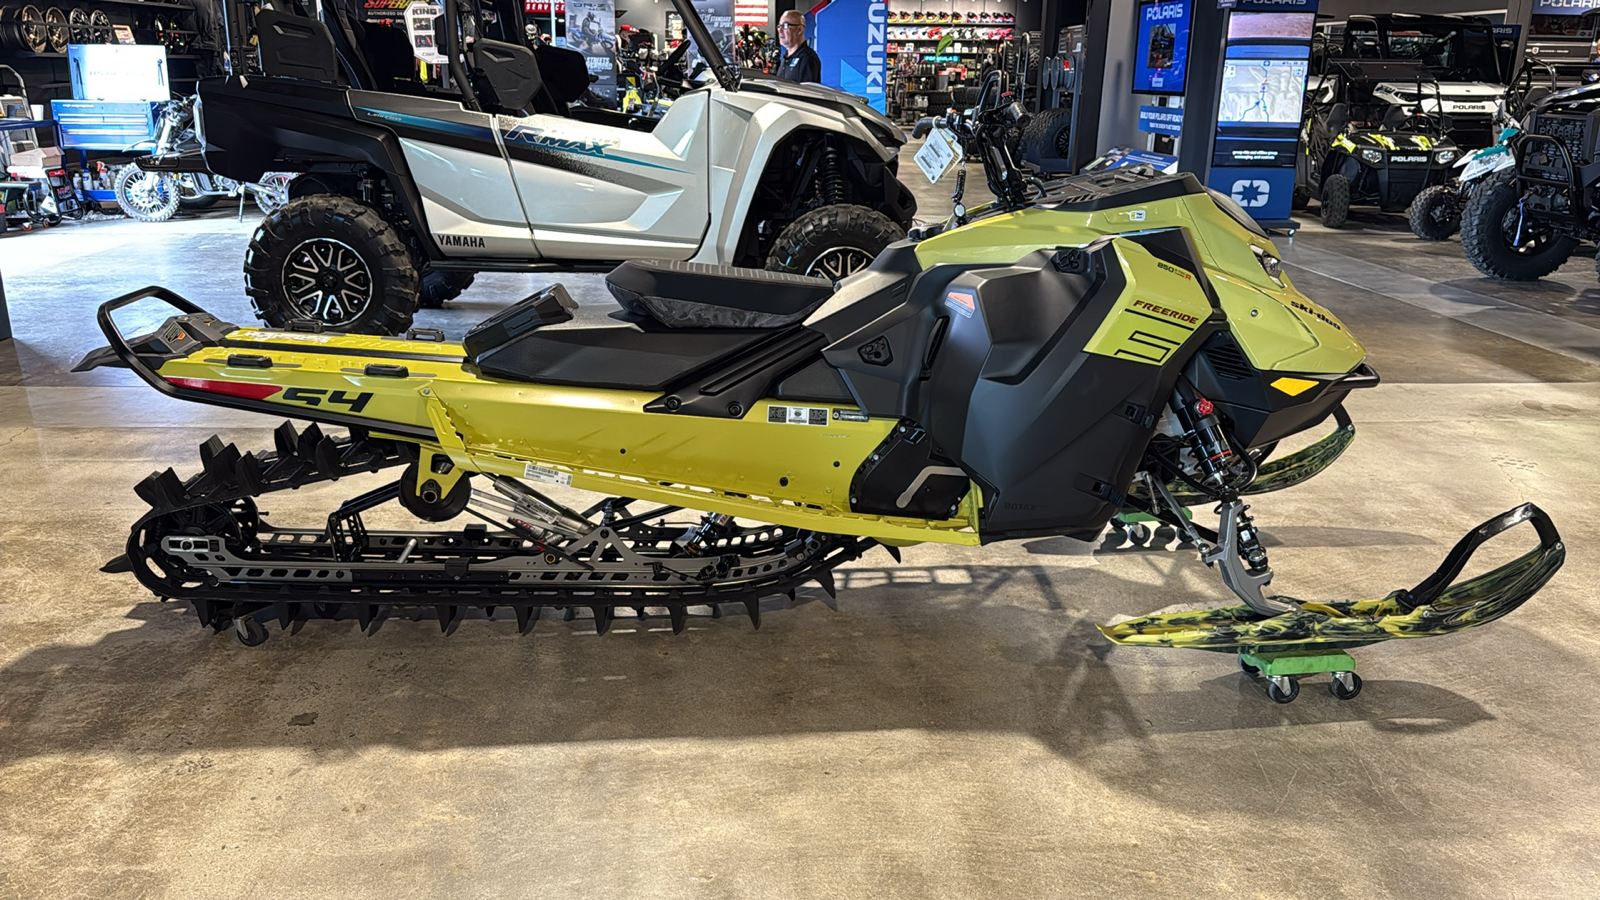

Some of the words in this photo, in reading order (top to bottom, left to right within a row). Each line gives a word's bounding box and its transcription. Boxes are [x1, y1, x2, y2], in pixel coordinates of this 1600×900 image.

[1146, 4, 1183, 20] POLARIS
[866, 0, 885, 94] UZUKI
[437, 234, 486, 249] YAMAHA
[1157, 262, 1175, 273] 850
[1132, 299, 1200, 325] FREERIDE
[1290, 300, 1342, 331] ski-doo
